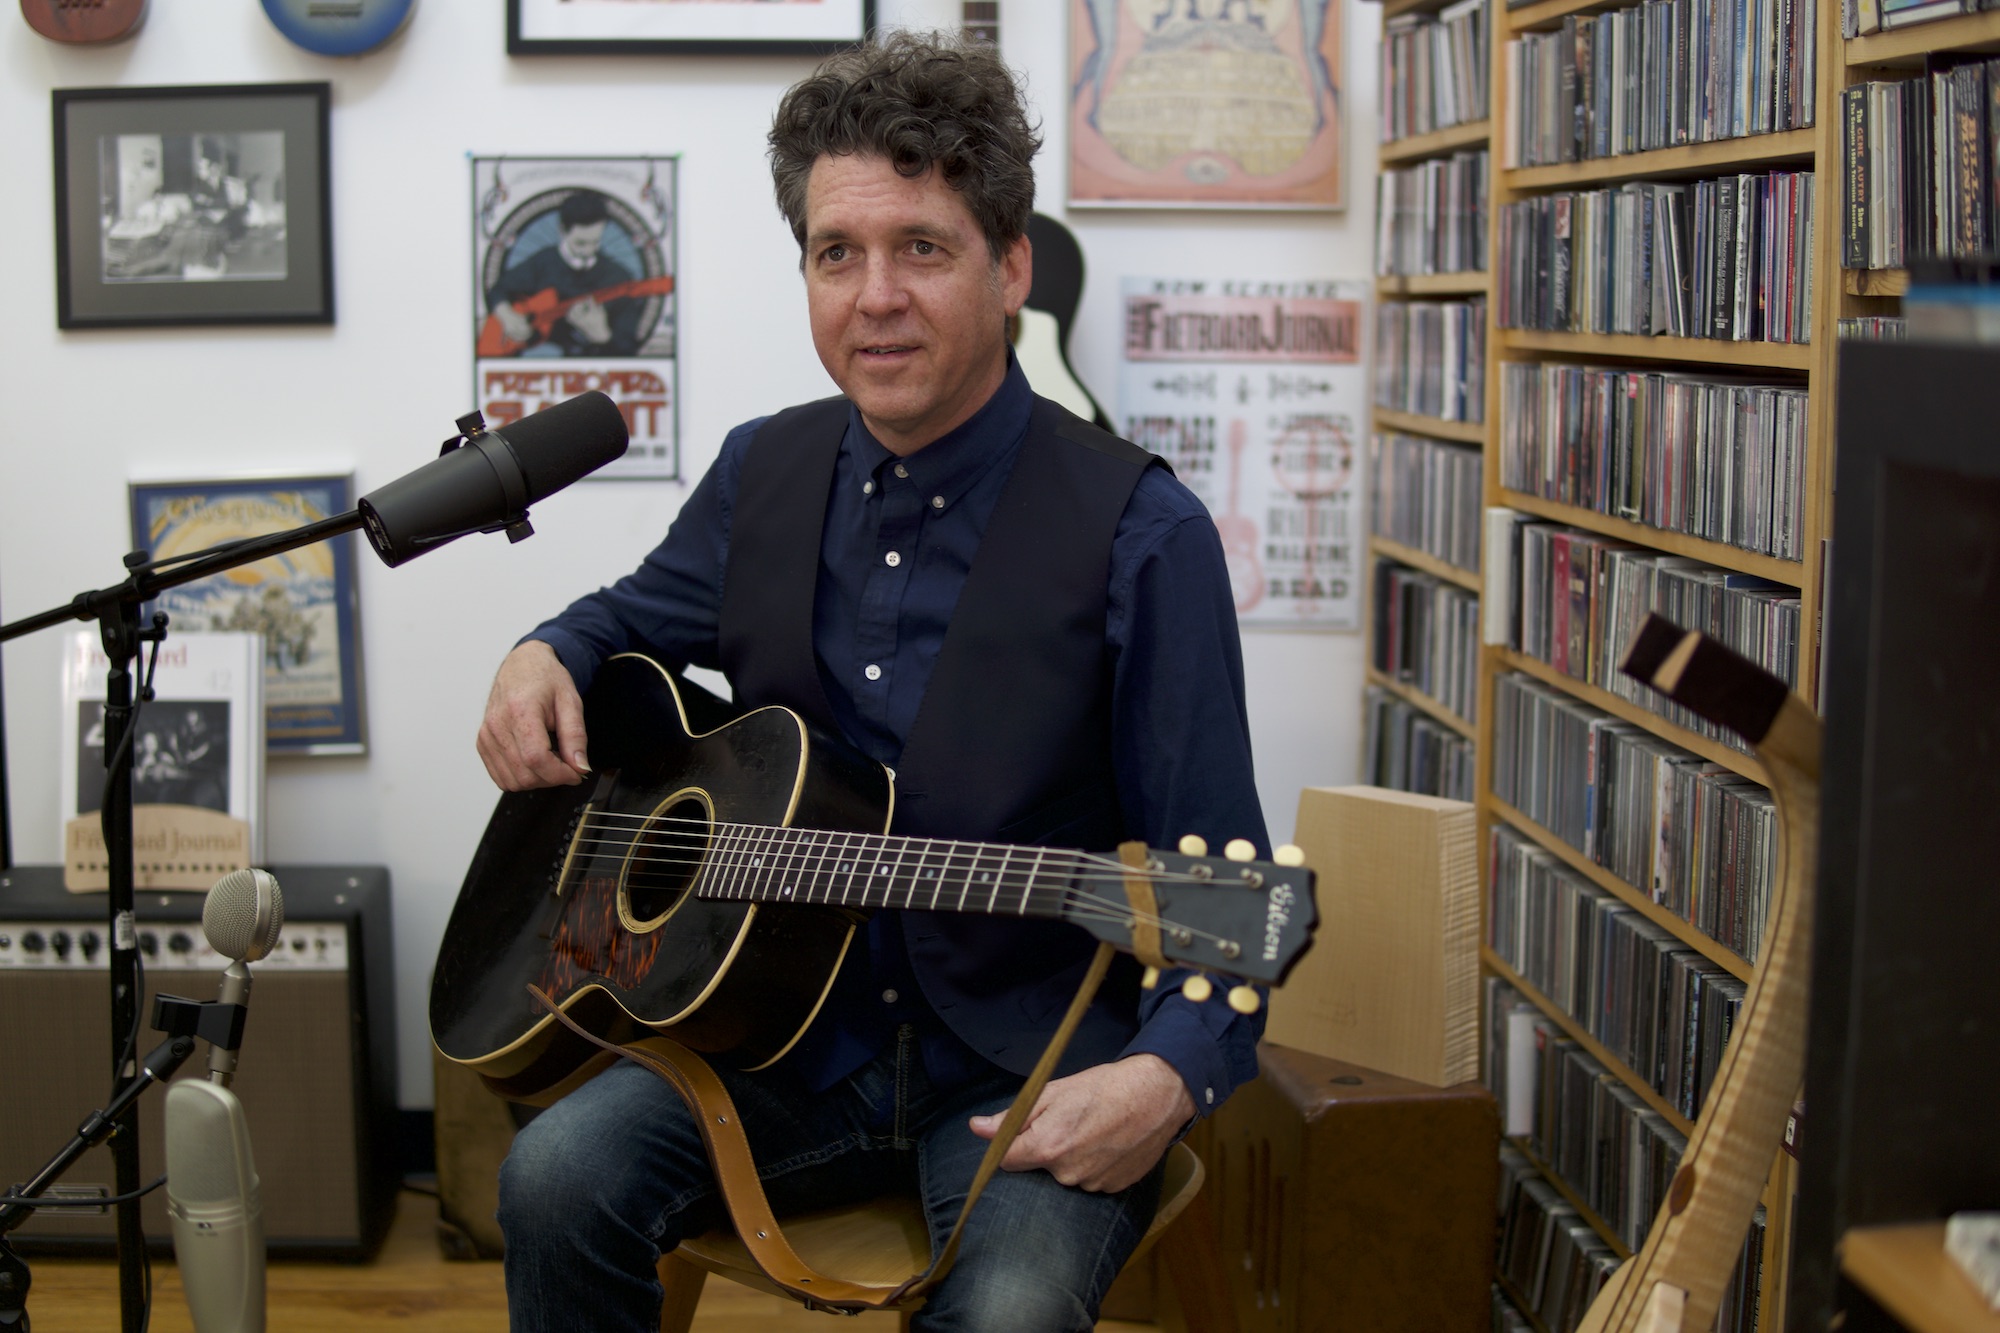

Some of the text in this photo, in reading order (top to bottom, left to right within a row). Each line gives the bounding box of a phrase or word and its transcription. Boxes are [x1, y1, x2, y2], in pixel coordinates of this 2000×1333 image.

[1849, 116, 1857, 146] Complete
[1856, 108, 1864, 123] The
[1850, 148, 1858, 168] 1950s
[1857, 127, 1865, 158] GENE
[1968, 116, 1979, 200] BILL
[1851, 169, 1859, 202] Television
[1857, 165, 1865, 203] AUTRY
[1643, 200, 1653, 225] BOB
[1850, 204, 1859, 240] Recordings
[1857, 207, 1865, 228] Show
[1642, 229, 1652, 281] DYLAN
[1143, 302, 1259, 351] FRETBOARD
[1259, 304, 1357, 356] JOURNAL
[485, 371, 667, 395] FRETBOARD
[1268, 579, 1349, 599] READ
[1263, 883, 1296, 961] Gibson
